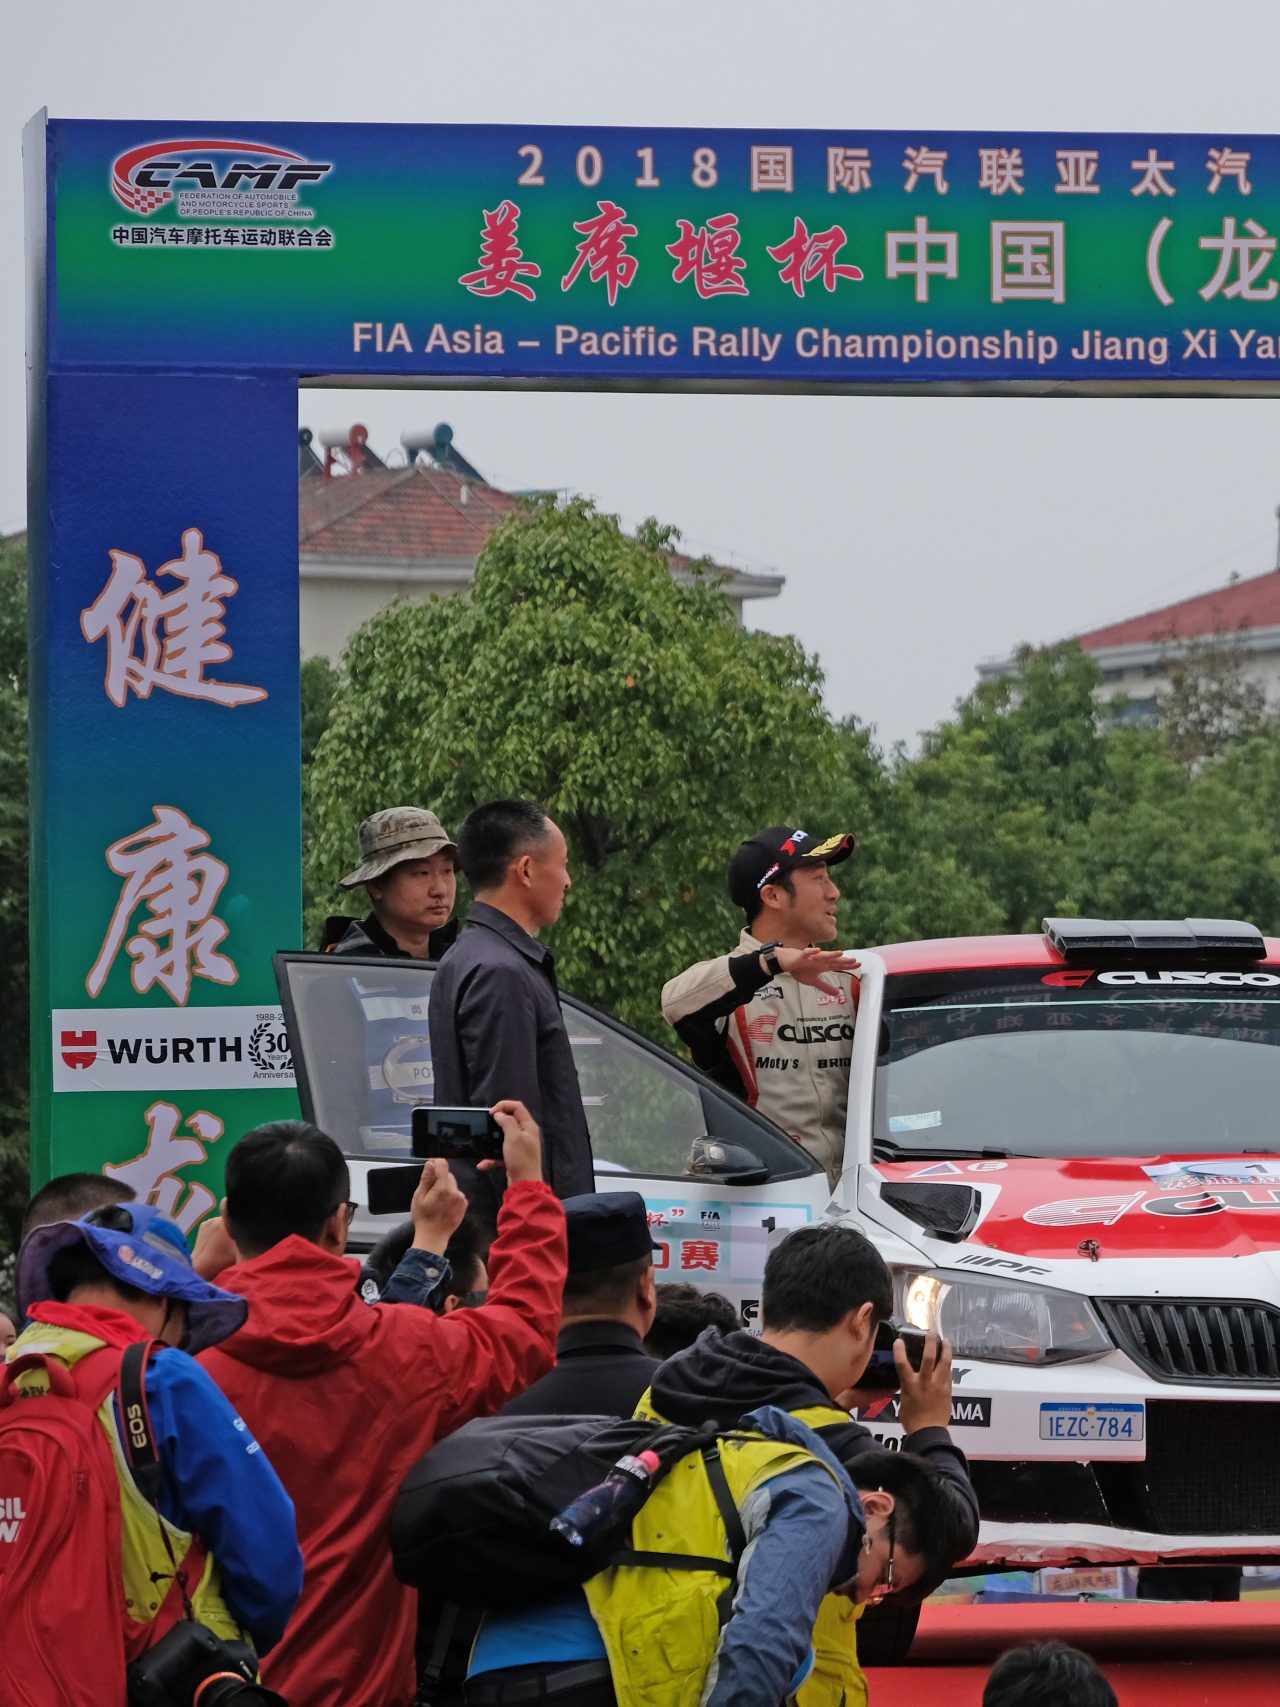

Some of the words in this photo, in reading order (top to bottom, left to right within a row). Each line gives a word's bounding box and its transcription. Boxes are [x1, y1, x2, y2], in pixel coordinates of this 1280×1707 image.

[135, 162, 332, 189] CAMF
[179, 192, 230, 201] FEDERATION
[232, 193, 243, 201] OF
[244, 193, 297, 201] AUTOMOBILE
[180, 200, 197, 208] AND
[256, 201, 289, 209] SPORTS
[180, 208, 191, 216] OF
[233, 209, 272, 217] REPUBLIC
[112, 226, 333, 248] 中国汽车摩托车运动联合会
[352, 322, 413, 353] FIA
[425, 323, 504, 355] Asia
[555, 324, 677, 356] Pacific
[692, 326, 781, 362] Rally
[795, 326, 1058, 364] Championship
[1072, 329, 1168, 365] Jiang
[1181, 328, 1217, 359] Xi
[255, 1013, 286, 1021] 1988-2
[777, 1023, 855, 1044] CUSCO
[107, 1037, 242, 1065] WÜRTH
[267, 1053, 288, 1063] Years
[253, 1071, 296, 1080] Anniversa
[1245, 1163, 1269, 1175] 1
[127, 1403, 147, 1449] EOS
